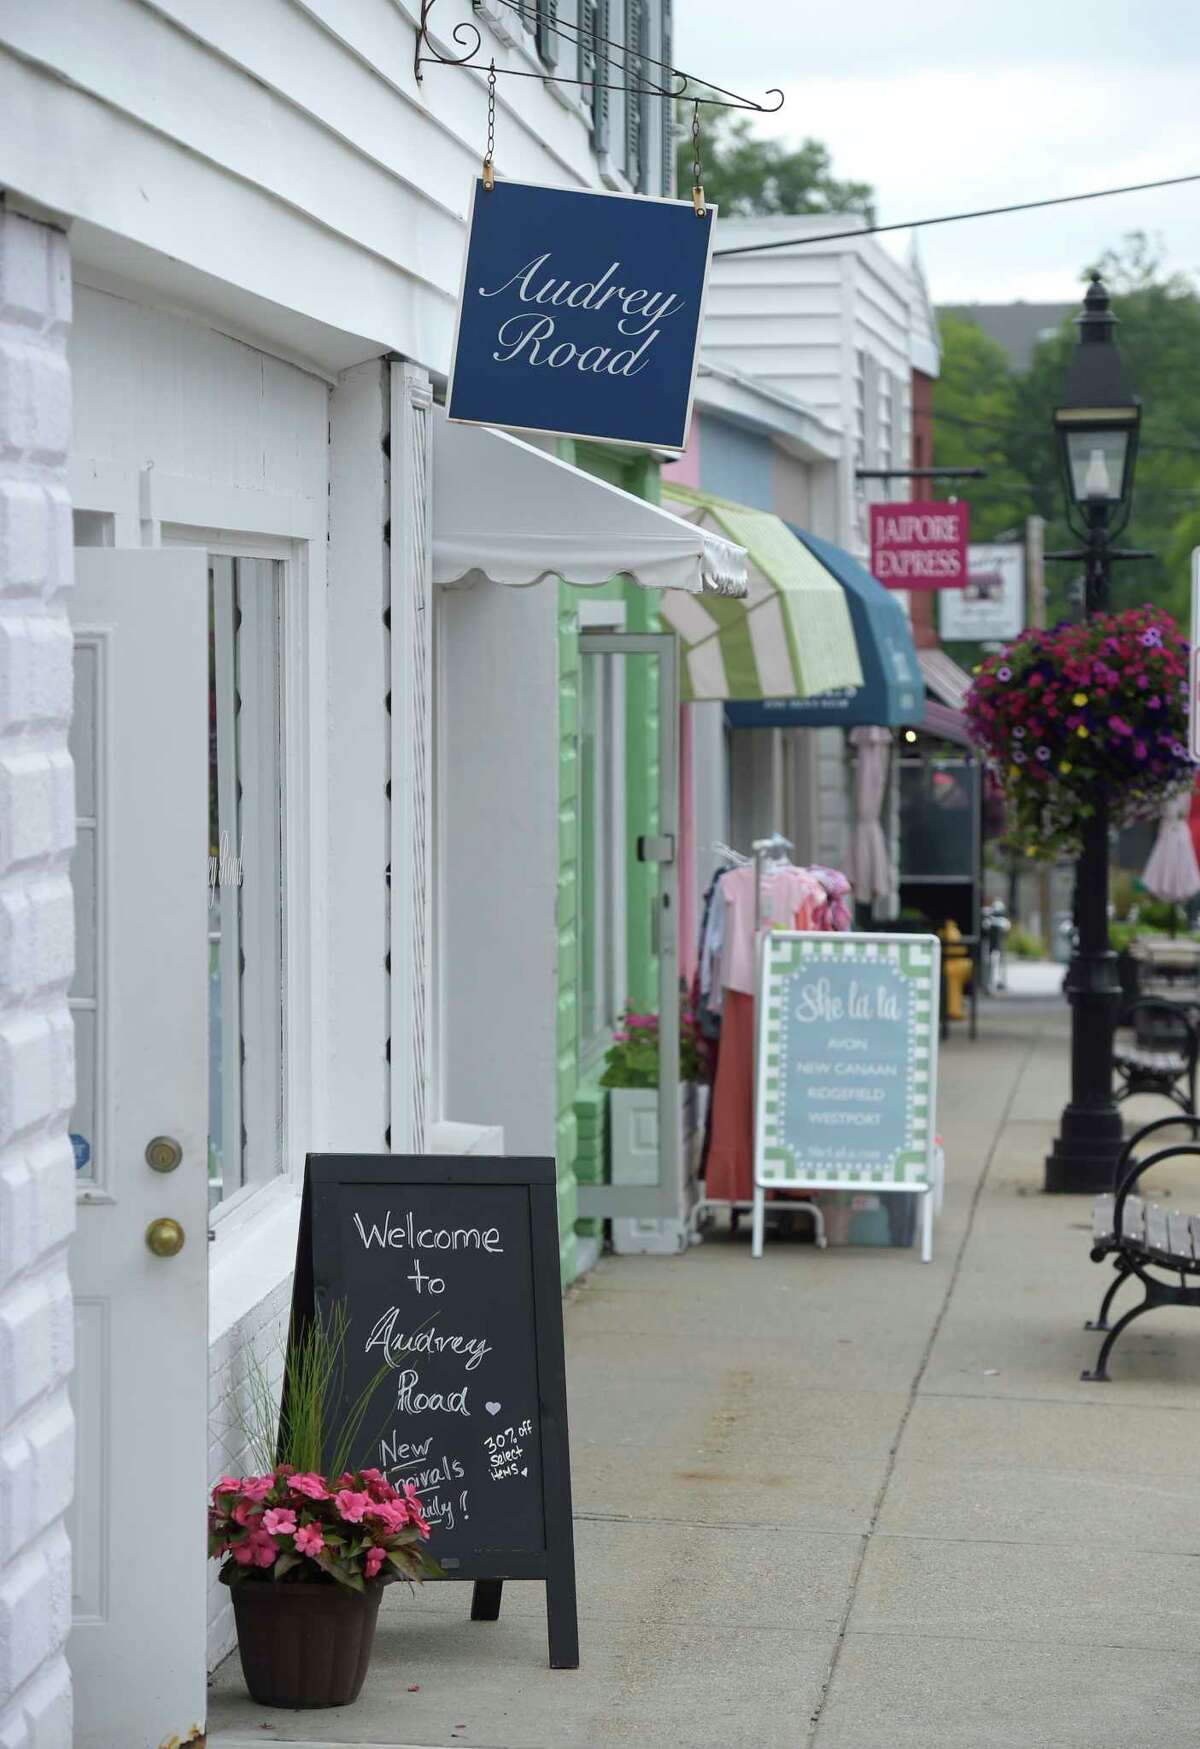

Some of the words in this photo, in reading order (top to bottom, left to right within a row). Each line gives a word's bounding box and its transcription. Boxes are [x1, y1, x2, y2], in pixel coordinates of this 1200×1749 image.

[478, 252, 686, 336] Audrey
[492, 312, 662, 377] Road
[876, 515, 961, 545] JAIPORE
[876, 549, 961, 577] EXPRESS
[795, 977, 845, 1023] She
[848, 981, 873, 1020] la
[876, 984, 902, 1021] la
[796, 1062, 831, 1075] NEW
[833, 1063, 897, 1077] CANAAN
[353, 1211, 504, 1253] Welcome
[407, 1259, 445, 1294] to
[365, 1306, 493, 1371] Audrey
[398, 1369, 471, 1417] Road
[379, 1429, 433, 1467] New
[483, 1427, 518, 1455] 30%
[518, 1419, 533, 1437] off
